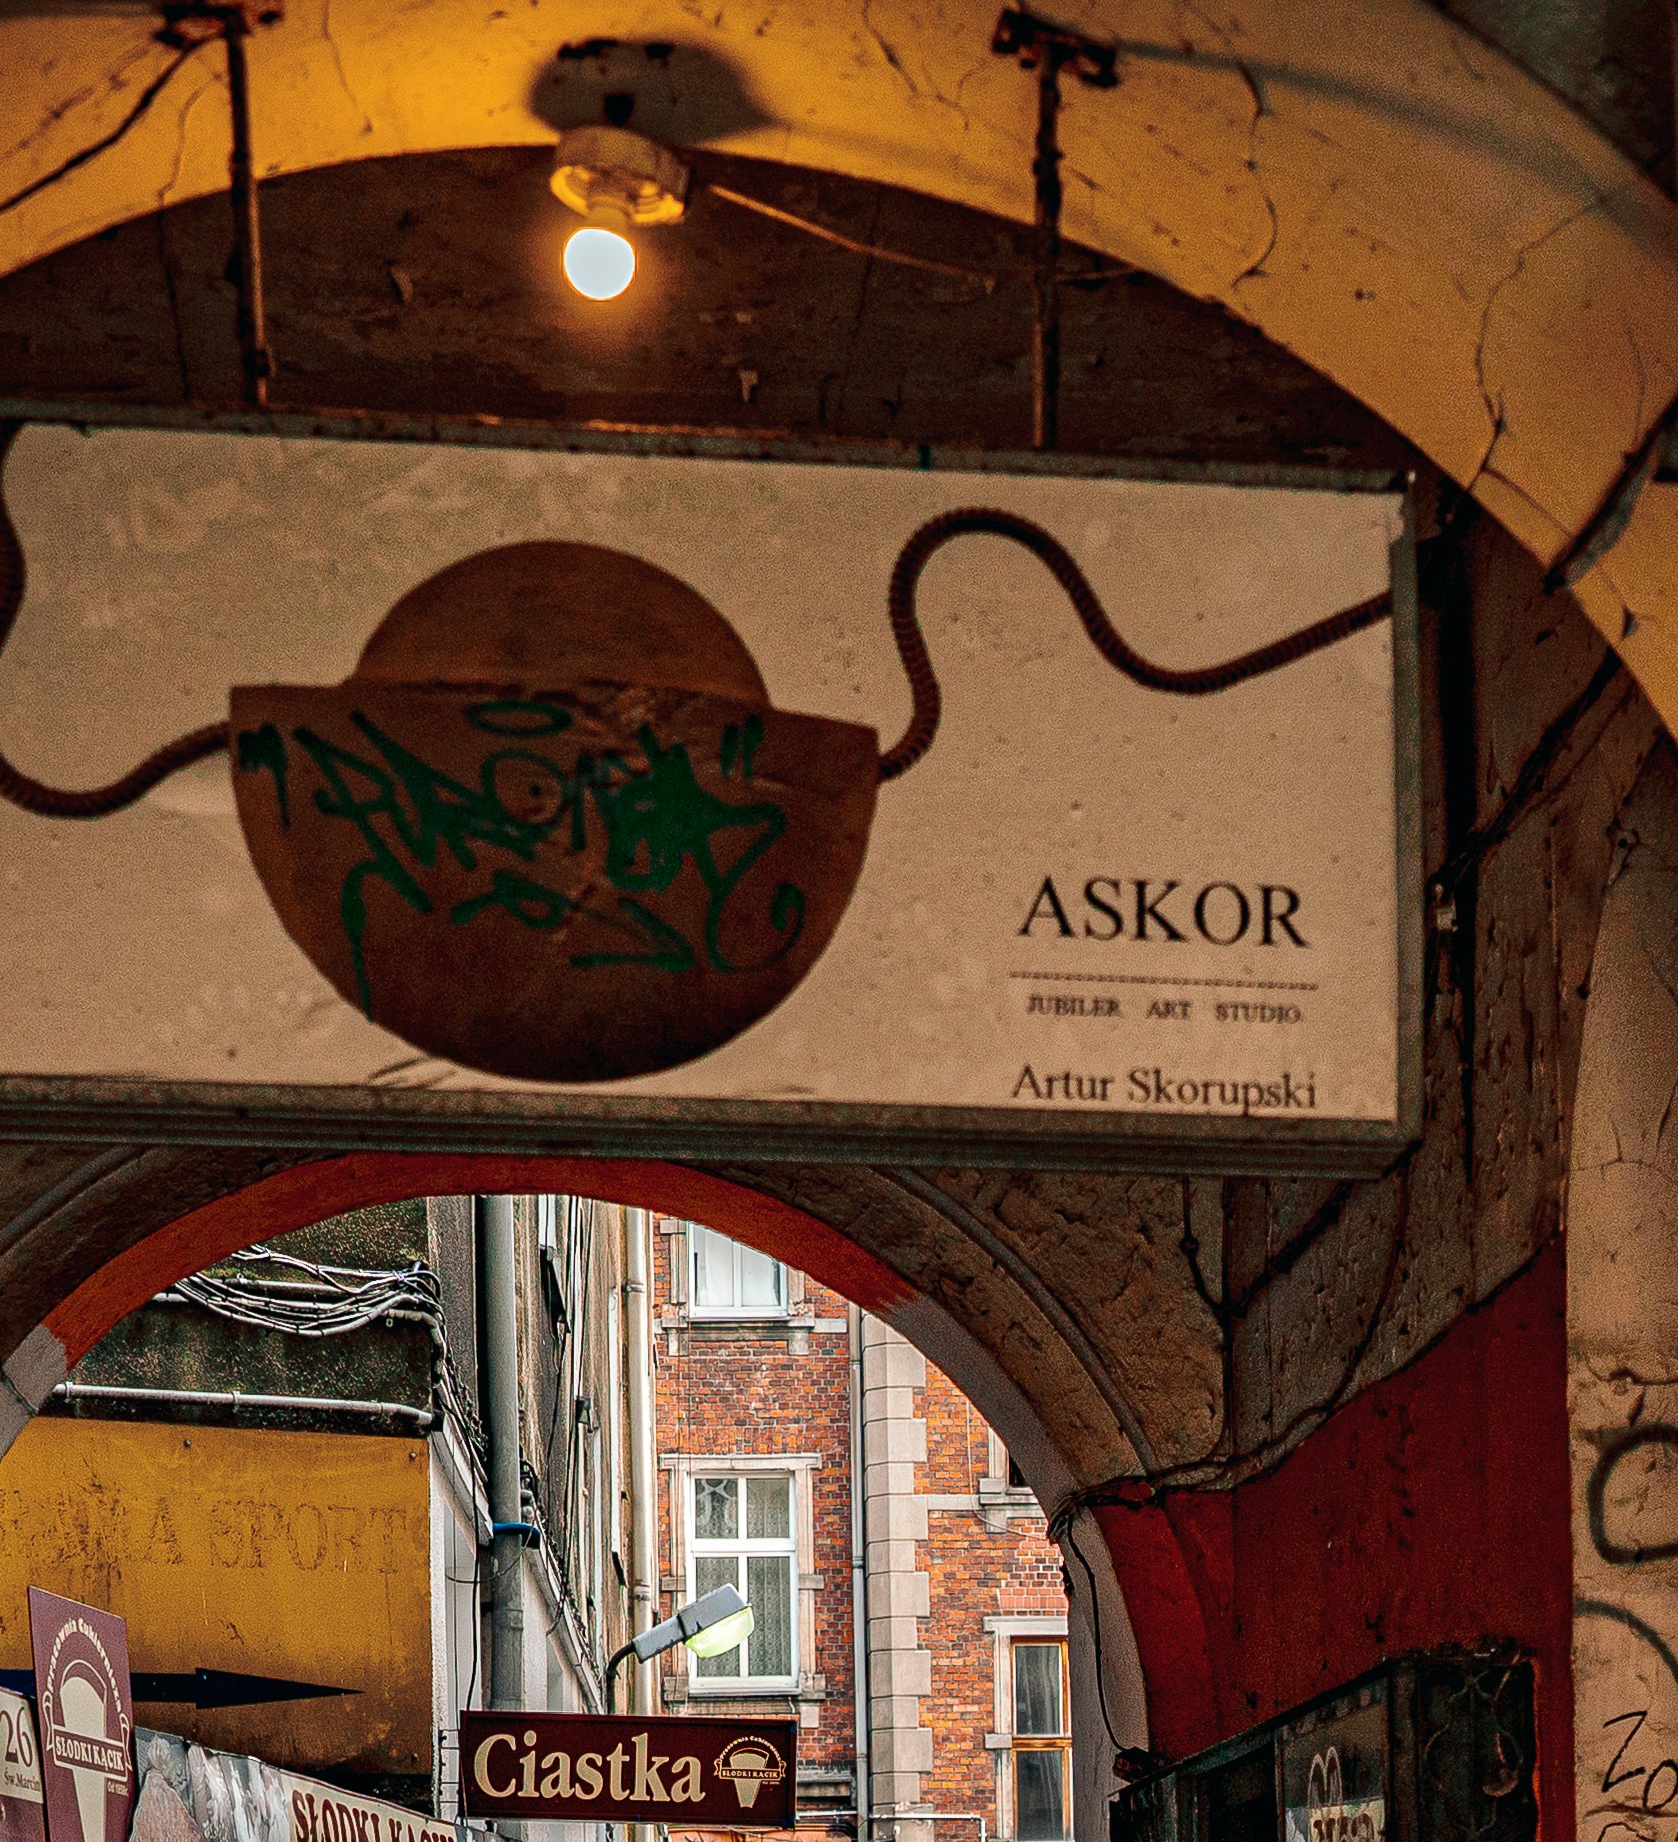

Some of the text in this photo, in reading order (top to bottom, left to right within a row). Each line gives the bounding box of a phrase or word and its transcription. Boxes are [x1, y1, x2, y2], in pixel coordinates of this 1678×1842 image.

[1017, 875, 1312, 949] ASKOR
[1026, 995, 1303, 1025] JUBILER ART STUDIO
[1012, 1063, 1317, 1118] Artur Skorupski
[55, 1734, 124, 1773] SŁODKI KĄCIK
[473, 1729, 707, 1805] Ciastka
